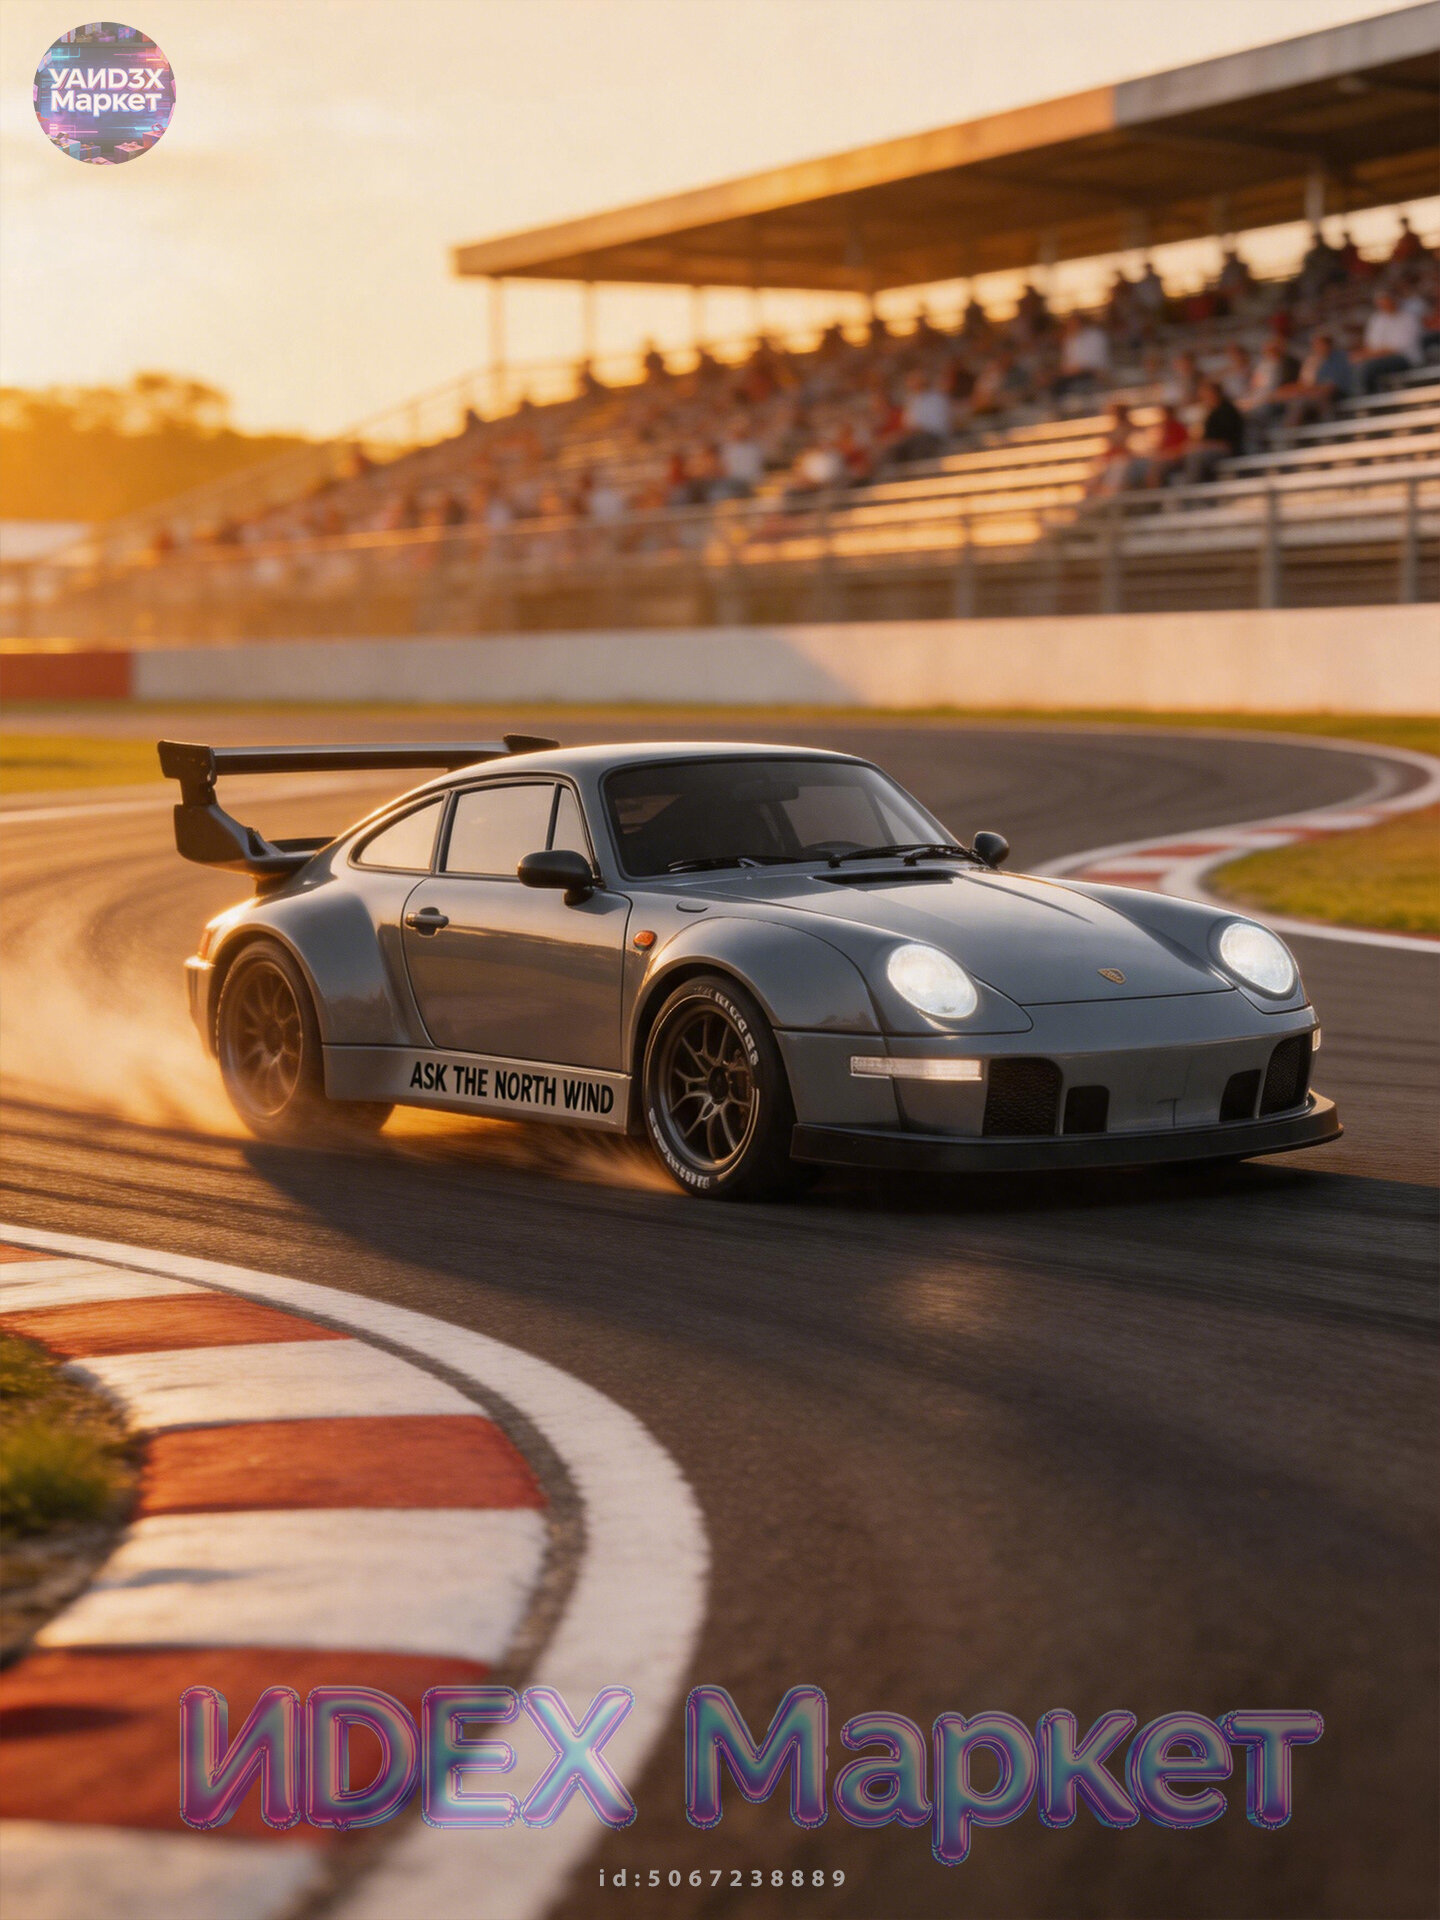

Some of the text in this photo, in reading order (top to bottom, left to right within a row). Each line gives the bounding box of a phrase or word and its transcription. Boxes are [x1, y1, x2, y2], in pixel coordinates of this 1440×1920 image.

[410, 1061, 615, 1114] ASK THE NORTH WIND
